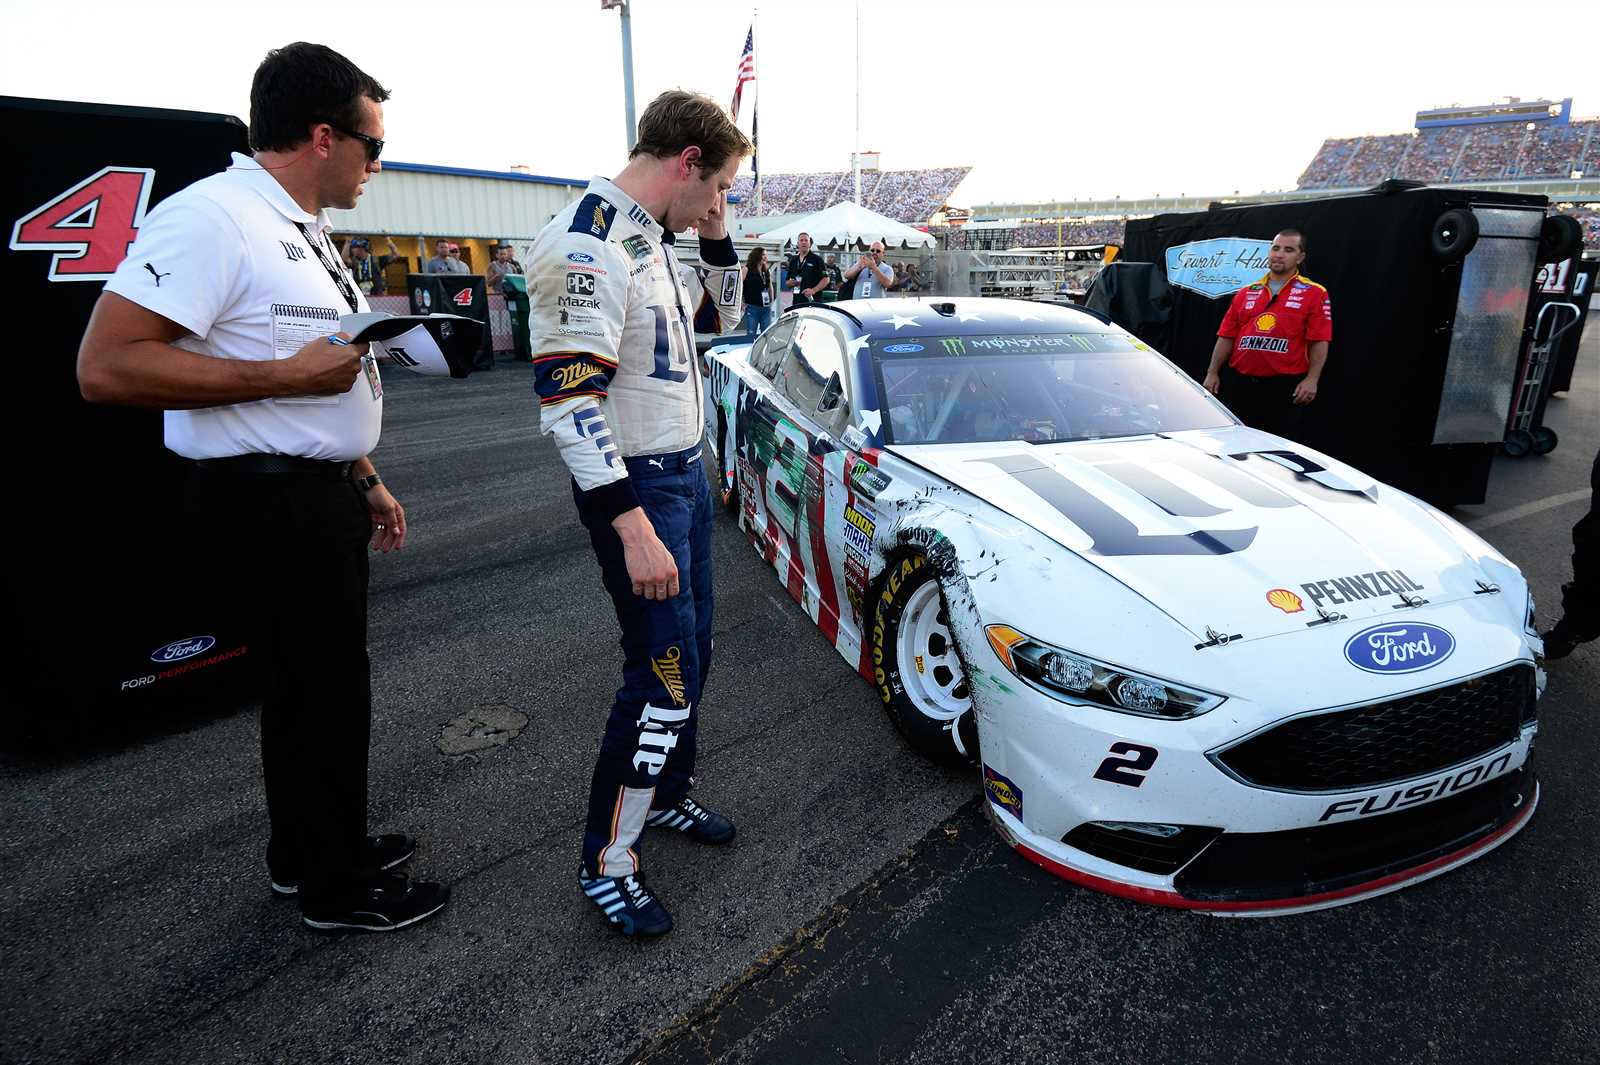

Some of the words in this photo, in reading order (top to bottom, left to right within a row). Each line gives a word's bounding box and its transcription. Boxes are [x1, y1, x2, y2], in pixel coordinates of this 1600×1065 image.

[9, 166, 155, 282] 4
[627, 204, 652, 228] Lite
[280, 240, 307, 261] Lite
[569, 253, 592, 262] Ford
[453, 288, 472, 305] 4
[567, 275, 594, 294] PPG
[558, 296, 600, 310] Mazak
[971, 337, 1070, 350] MONSTER
[1239, 336, 1288, 353] PENNZOIL
[552, 362, 604, 390] Miller
[845, 506, 874, 537] MOOG
[844, 523, 873, 556] MAHLE
[1300, 569, 1424, 607] PENNZOIL
[163, 639, 204, 660] Ford
[121, 674, 156, 691] FORD
[159, 646, 248, 680] PERFORMANCE
[651, 646, 688, 707] Miller
[1093, 742, 1159, 787] 2
[985, 778, 1021, 809] SUNOCO
[1319, 752, 1511, 822] FUSION
